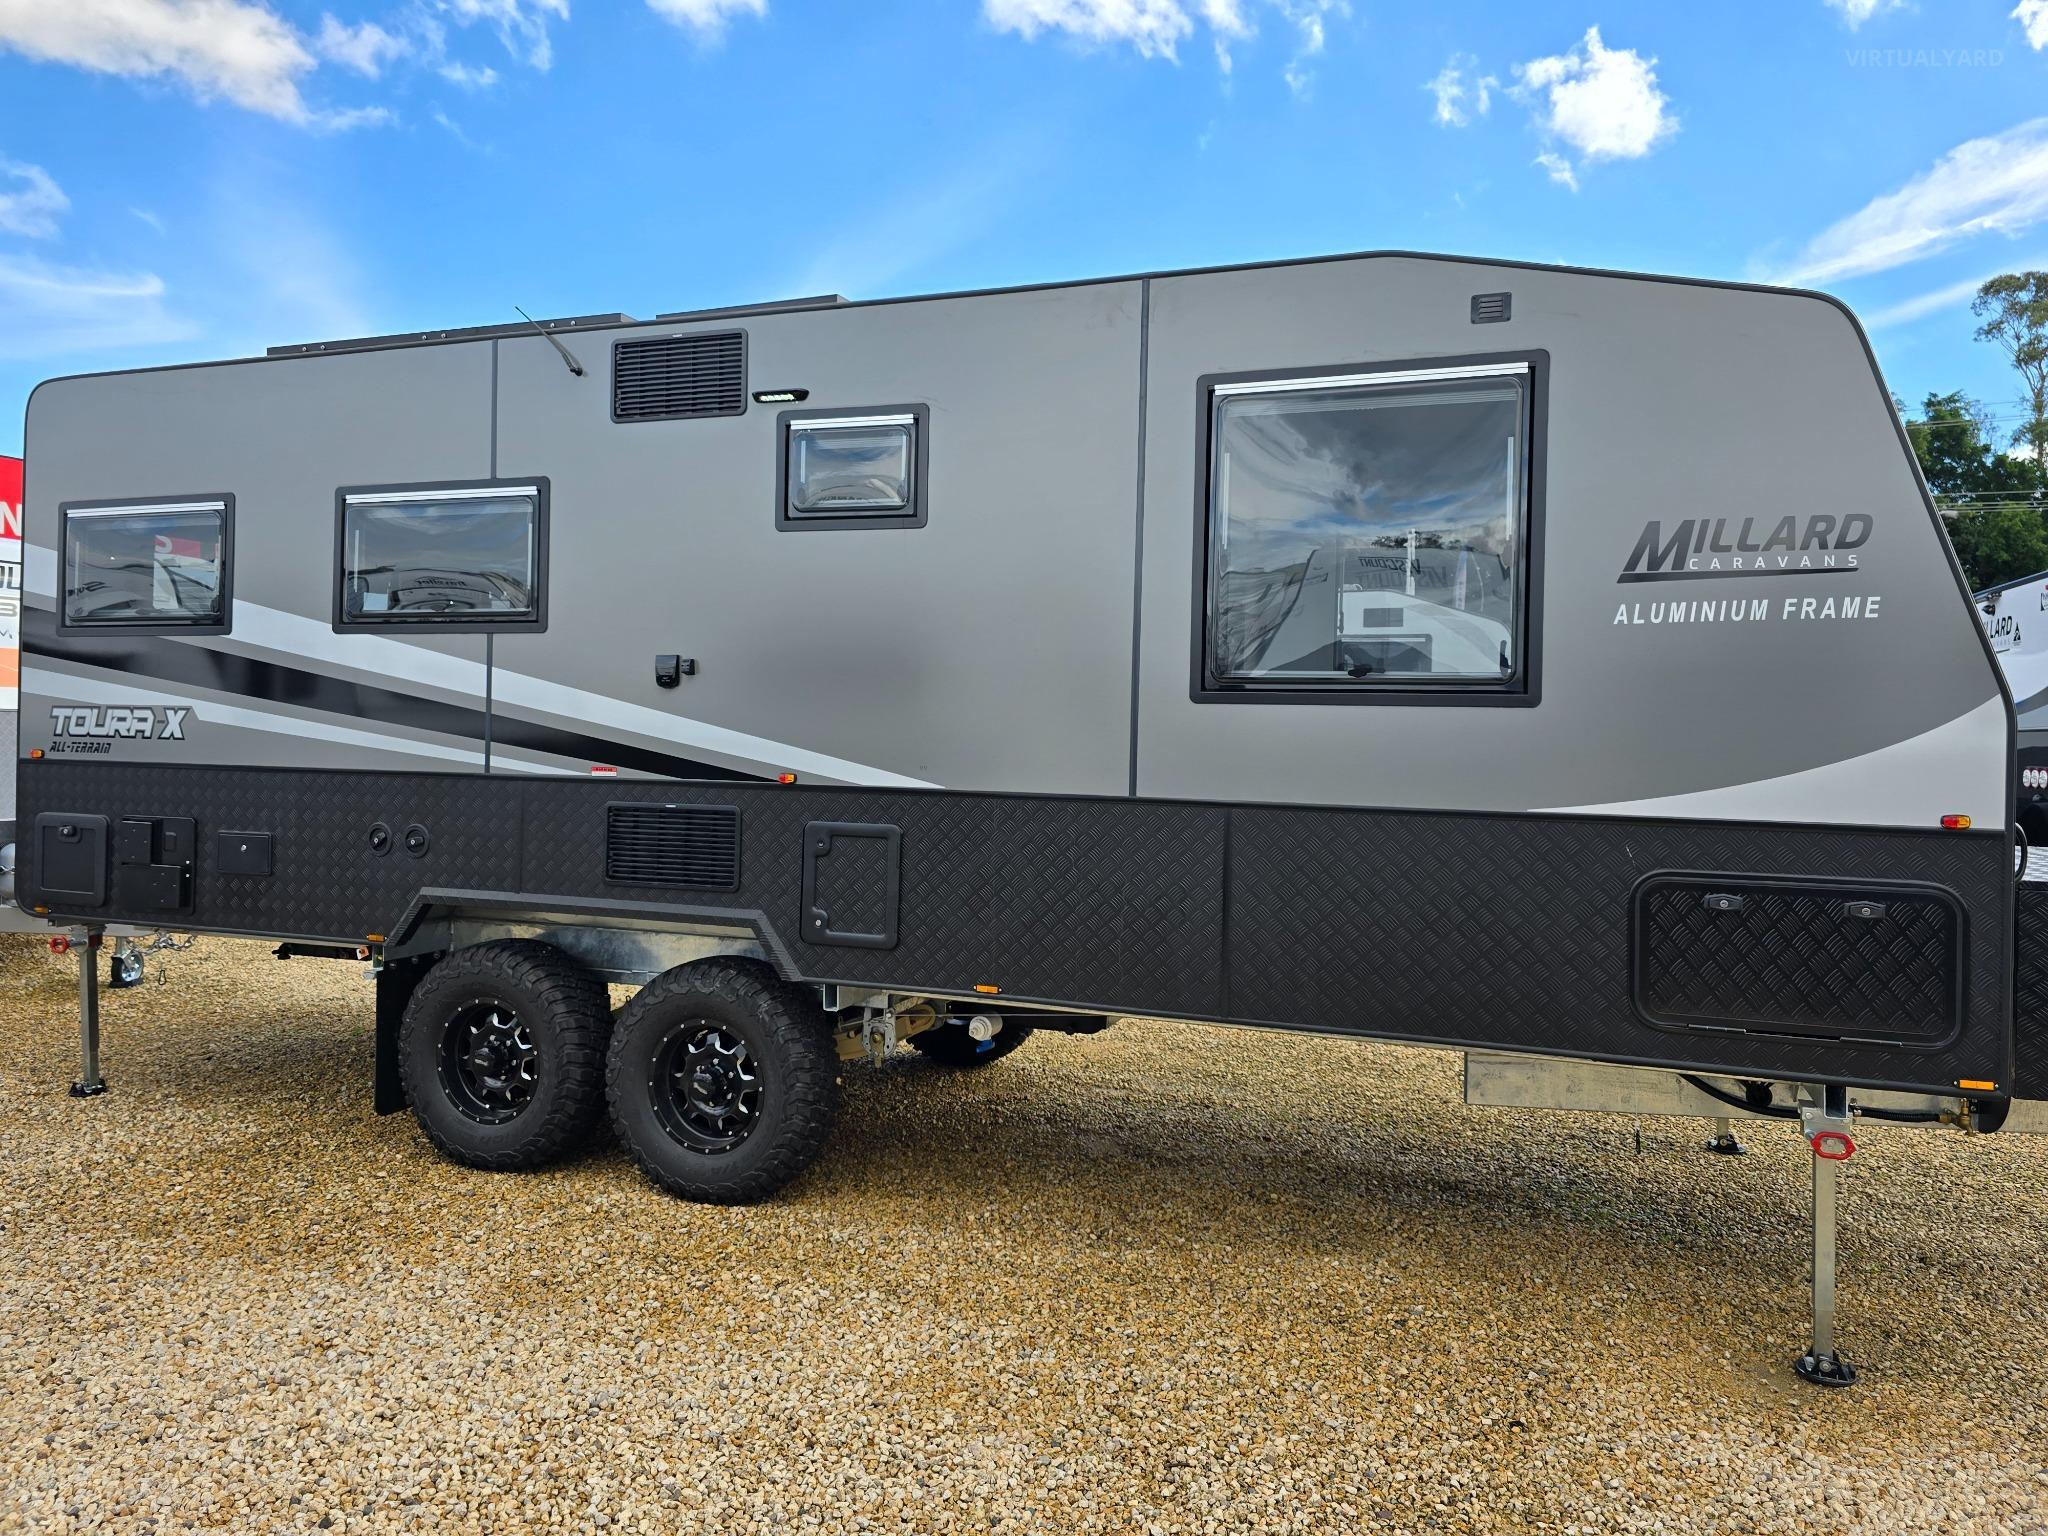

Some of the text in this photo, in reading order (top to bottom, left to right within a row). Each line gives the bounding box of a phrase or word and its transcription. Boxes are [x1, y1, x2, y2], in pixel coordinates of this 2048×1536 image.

[1622, 513, 1874, 572] MILLARD
[1689, 554, 1858, 570] CARAVANS
[1613, 596, 1881, 625] ALUMINIUM FRAME
[49, 741, 112, 754] ALL-TERRAIN
